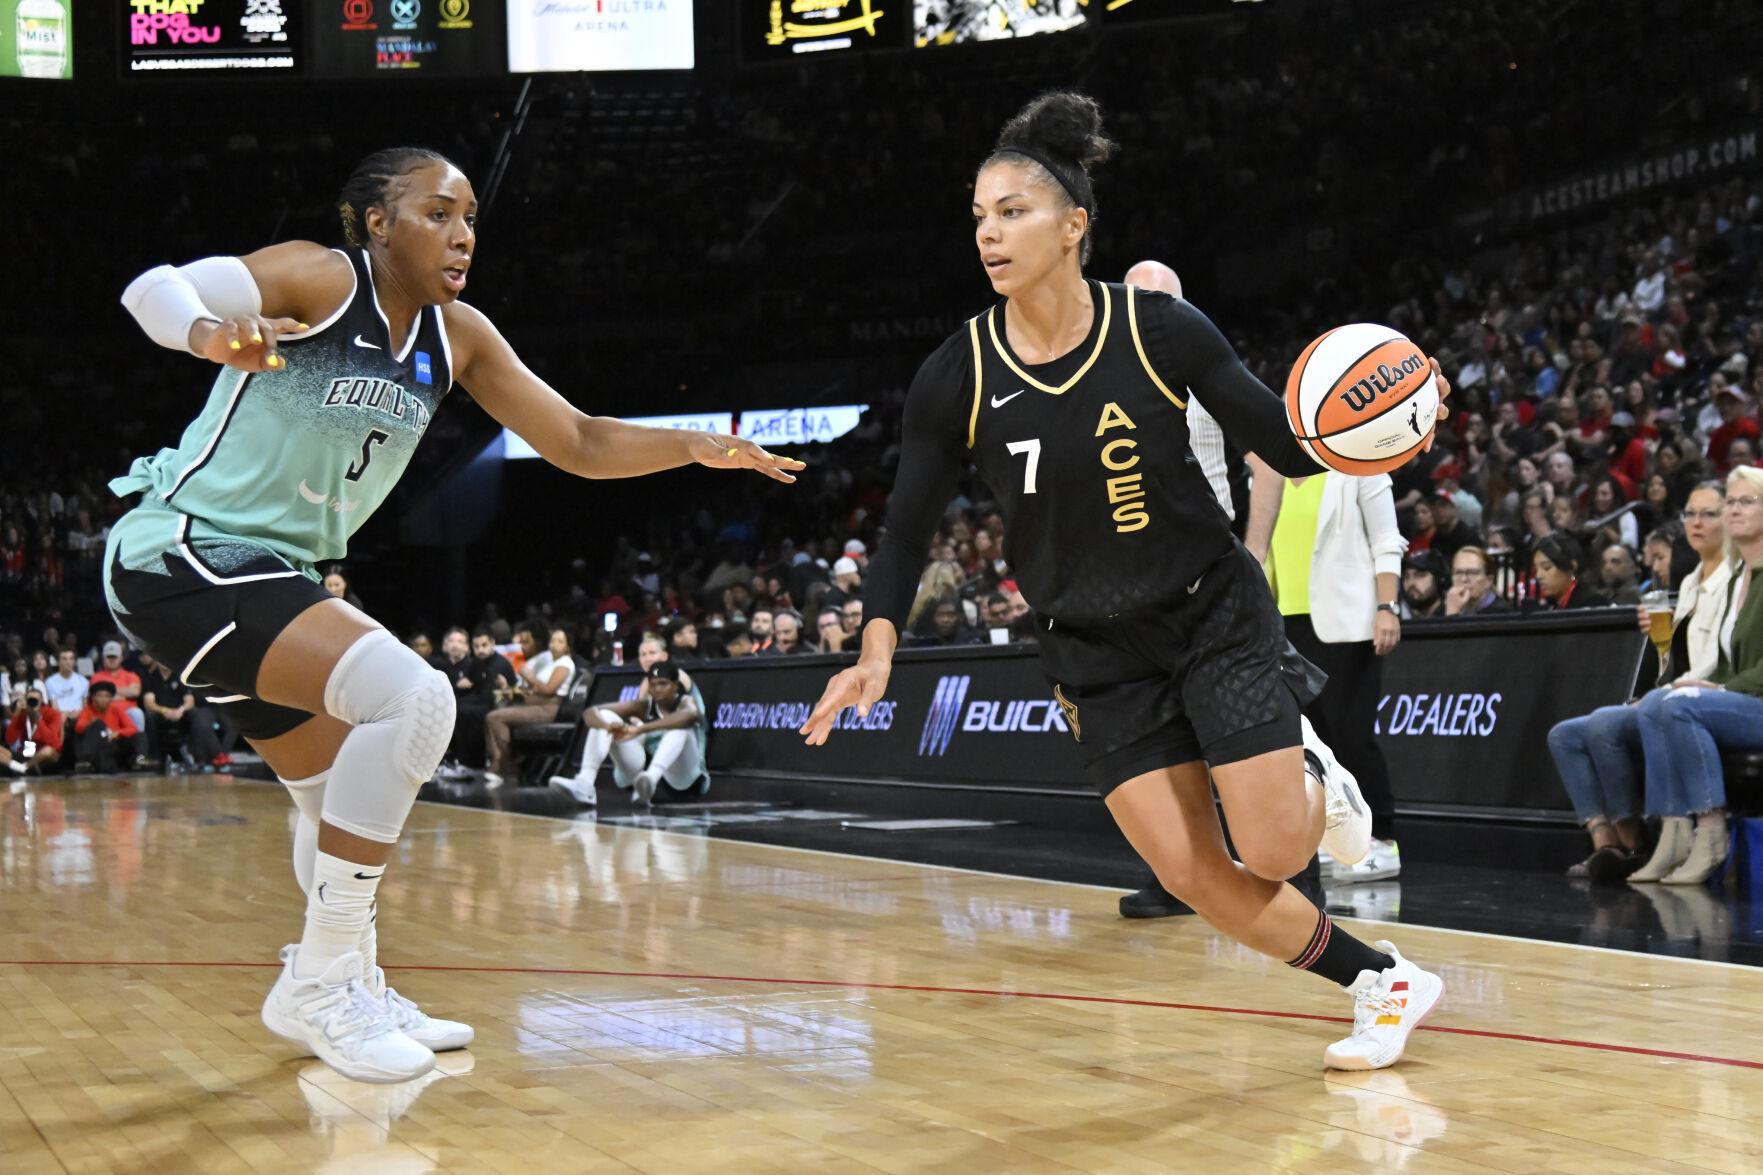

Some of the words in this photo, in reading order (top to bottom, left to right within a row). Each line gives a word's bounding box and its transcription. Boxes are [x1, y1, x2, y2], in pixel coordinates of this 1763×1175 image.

[131, 0, 202, 14] THAT
[131, 14, 189, 29] DOG
[574, 21, 629, 31] ARENA
[131, 28, 157, 44] IN
[167, 27, 220, 42] YOU
[1531, 132, 1756, 218] ACESTEAMSHOP.COM
[1340, 353, 1424, 412] Wilson
[323, 376, 430, 441] EQULTY
[752, 414, 834, 437] ARENA
[344, 430, 390, 482] 5
[1005, 438, 1042, 494] 7
[1095, 401, 1150, 533] ACES
[713, 702, 769, 729] SOUTHERN
[962, 699, 1069, 733] BUICK
[1388, 692, 1502, 737] DEALERS
